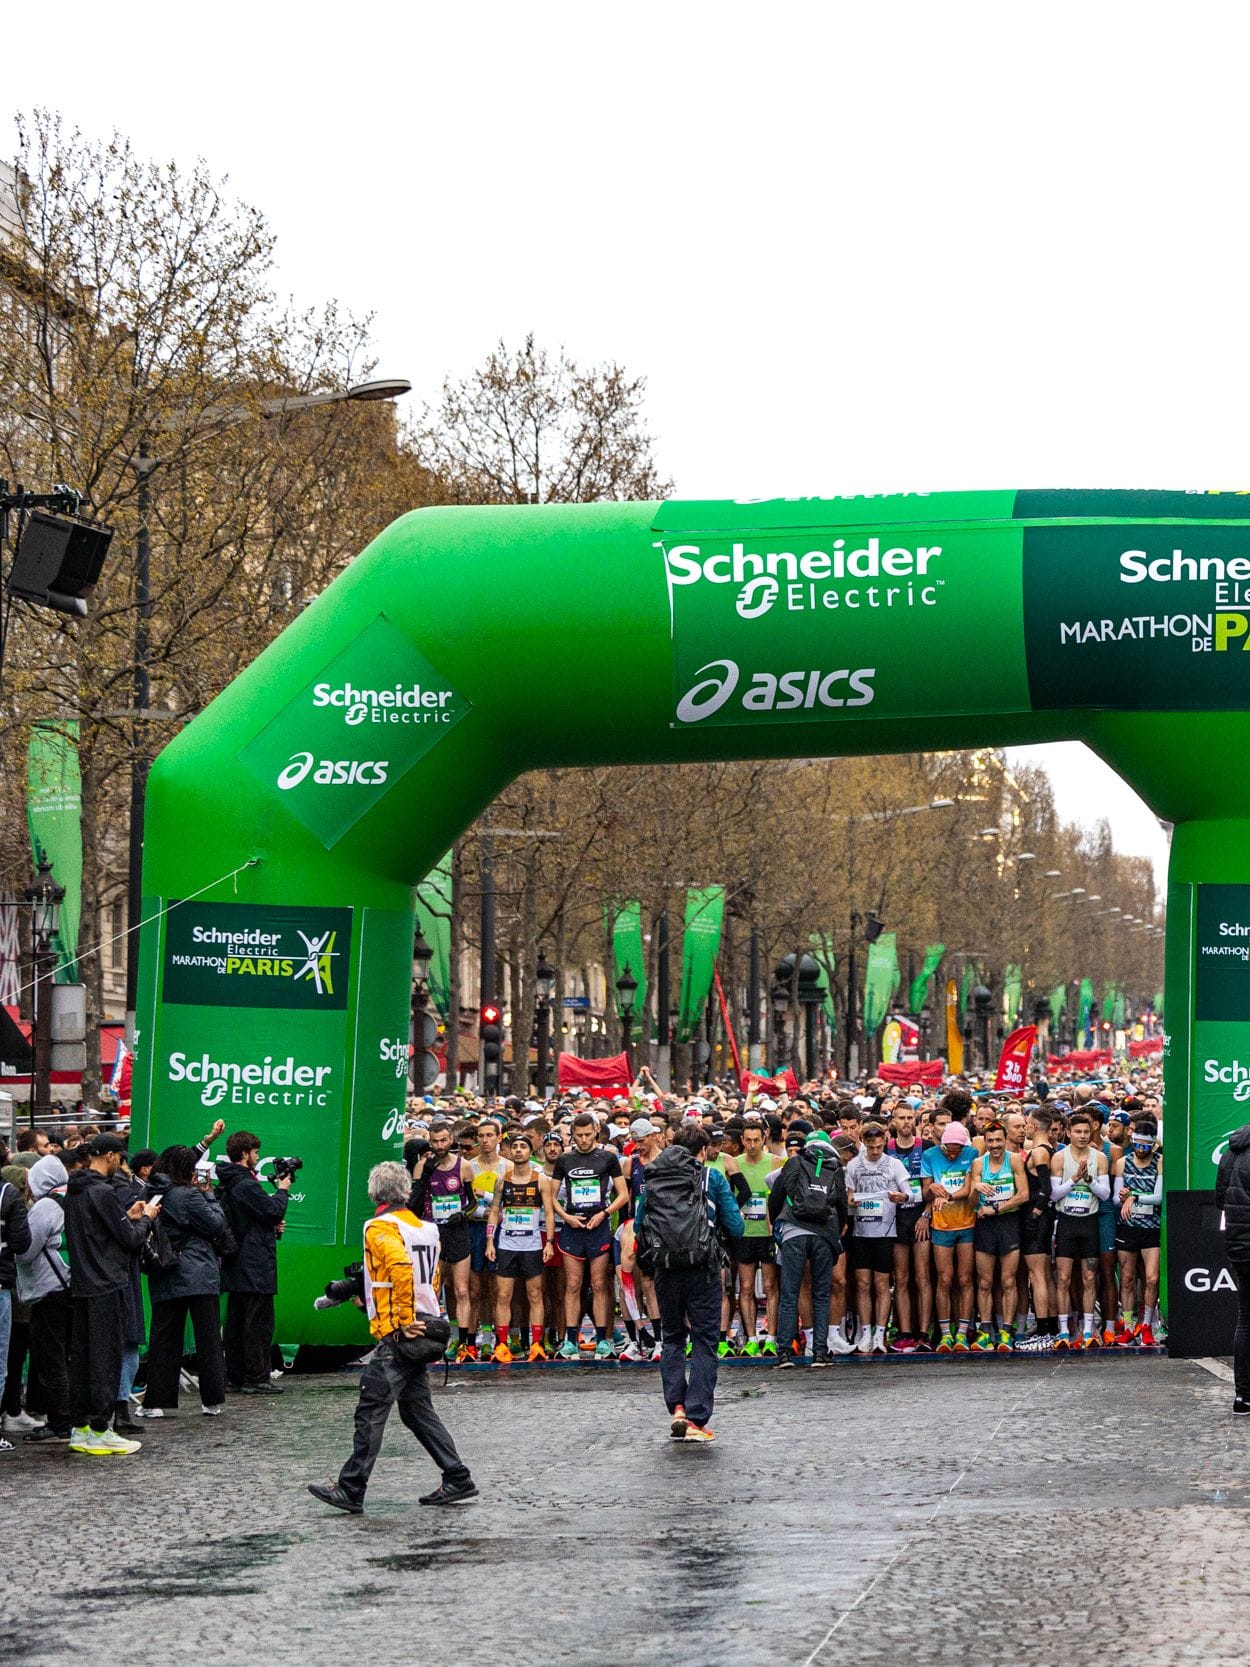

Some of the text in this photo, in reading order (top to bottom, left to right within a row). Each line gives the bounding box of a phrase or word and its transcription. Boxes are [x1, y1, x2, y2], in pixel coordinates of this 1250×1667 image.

[668, 538, 943, 585] Schneider
[1060, 613, 1213, 645] MARATHON
[1192, 637, 1212, 653] DE
[312, 682, 453, 707] Schneider
[371, 709, 451, 723] Electric
[192, 926, 282, 946] Schneider
[227, 944, 278, 956] Electric
[1202, 946, 1249, 955] MARATHON
[172, 955, 294, 976] MARATHON DE PARIS
[169, 1052, 331, 1087] Schneider
[231, 1086, 327, 1106] Electric
[288, 1192, 305, 1202] ody
[411, 1245, 437, 1285] TV
